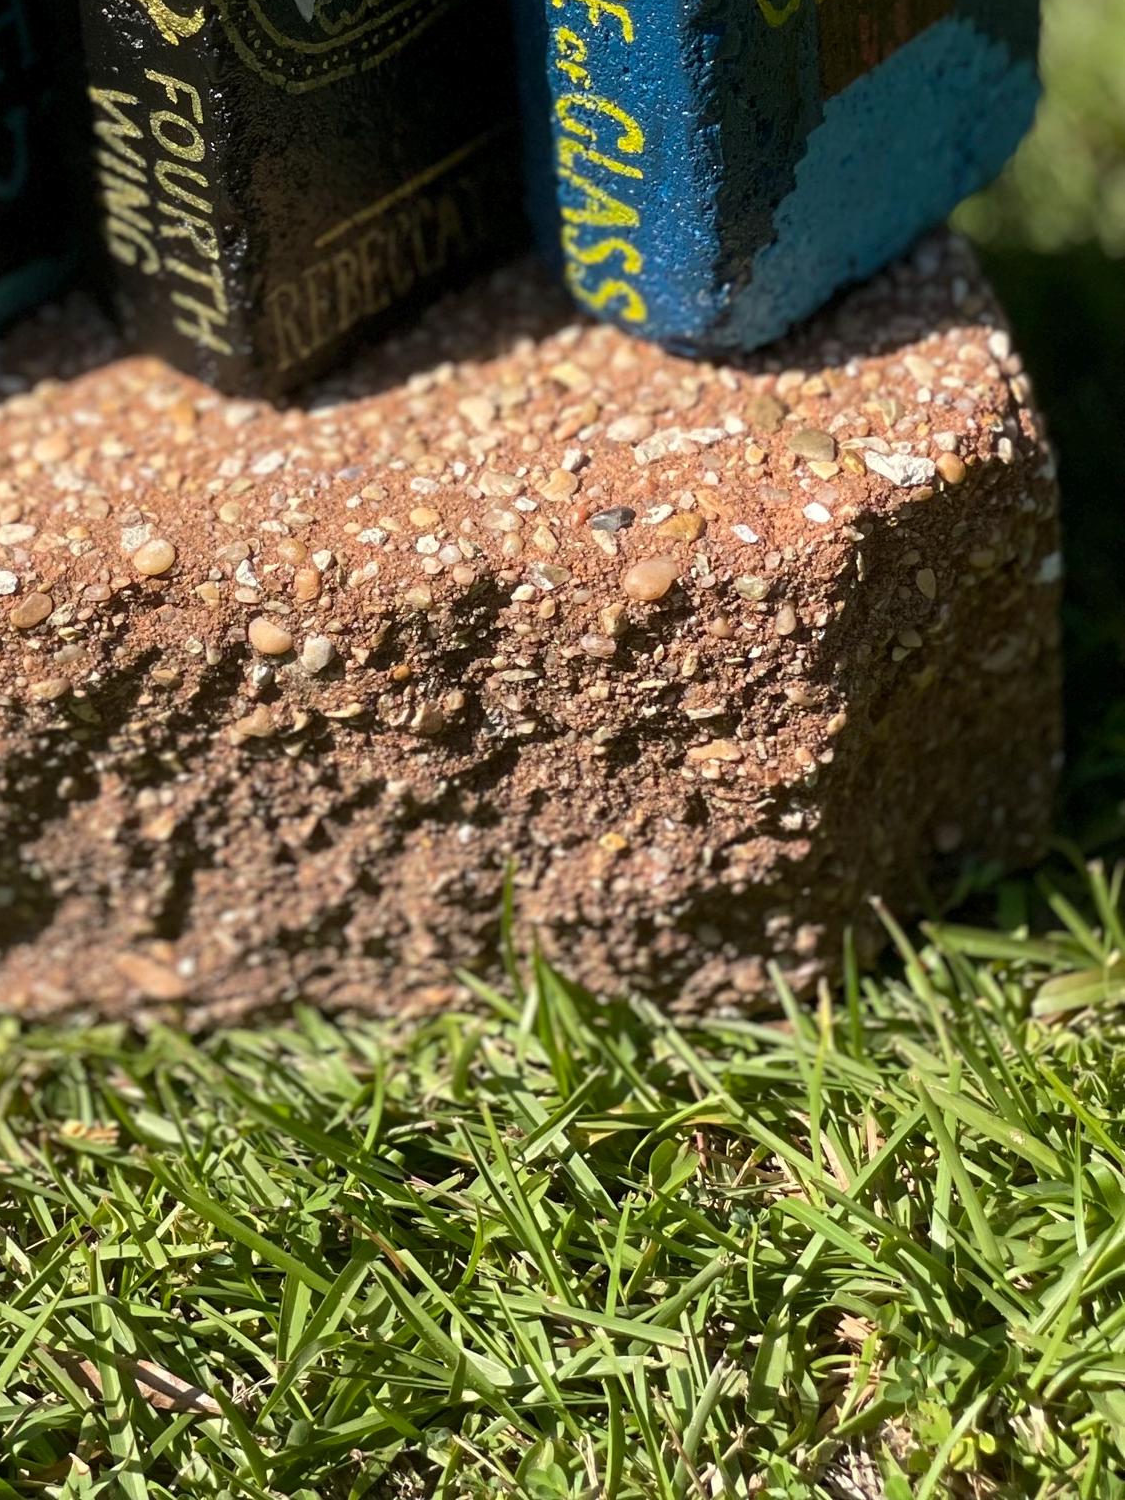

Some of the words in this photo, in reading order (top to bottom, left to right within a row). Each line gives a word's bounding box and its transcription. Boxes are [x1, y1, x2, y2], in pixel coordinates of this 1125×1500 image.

[87, 85, 162, 277] WING
[142, 66, 234, 357] FOURTH
[554, 92, 648, 324] GLASS
